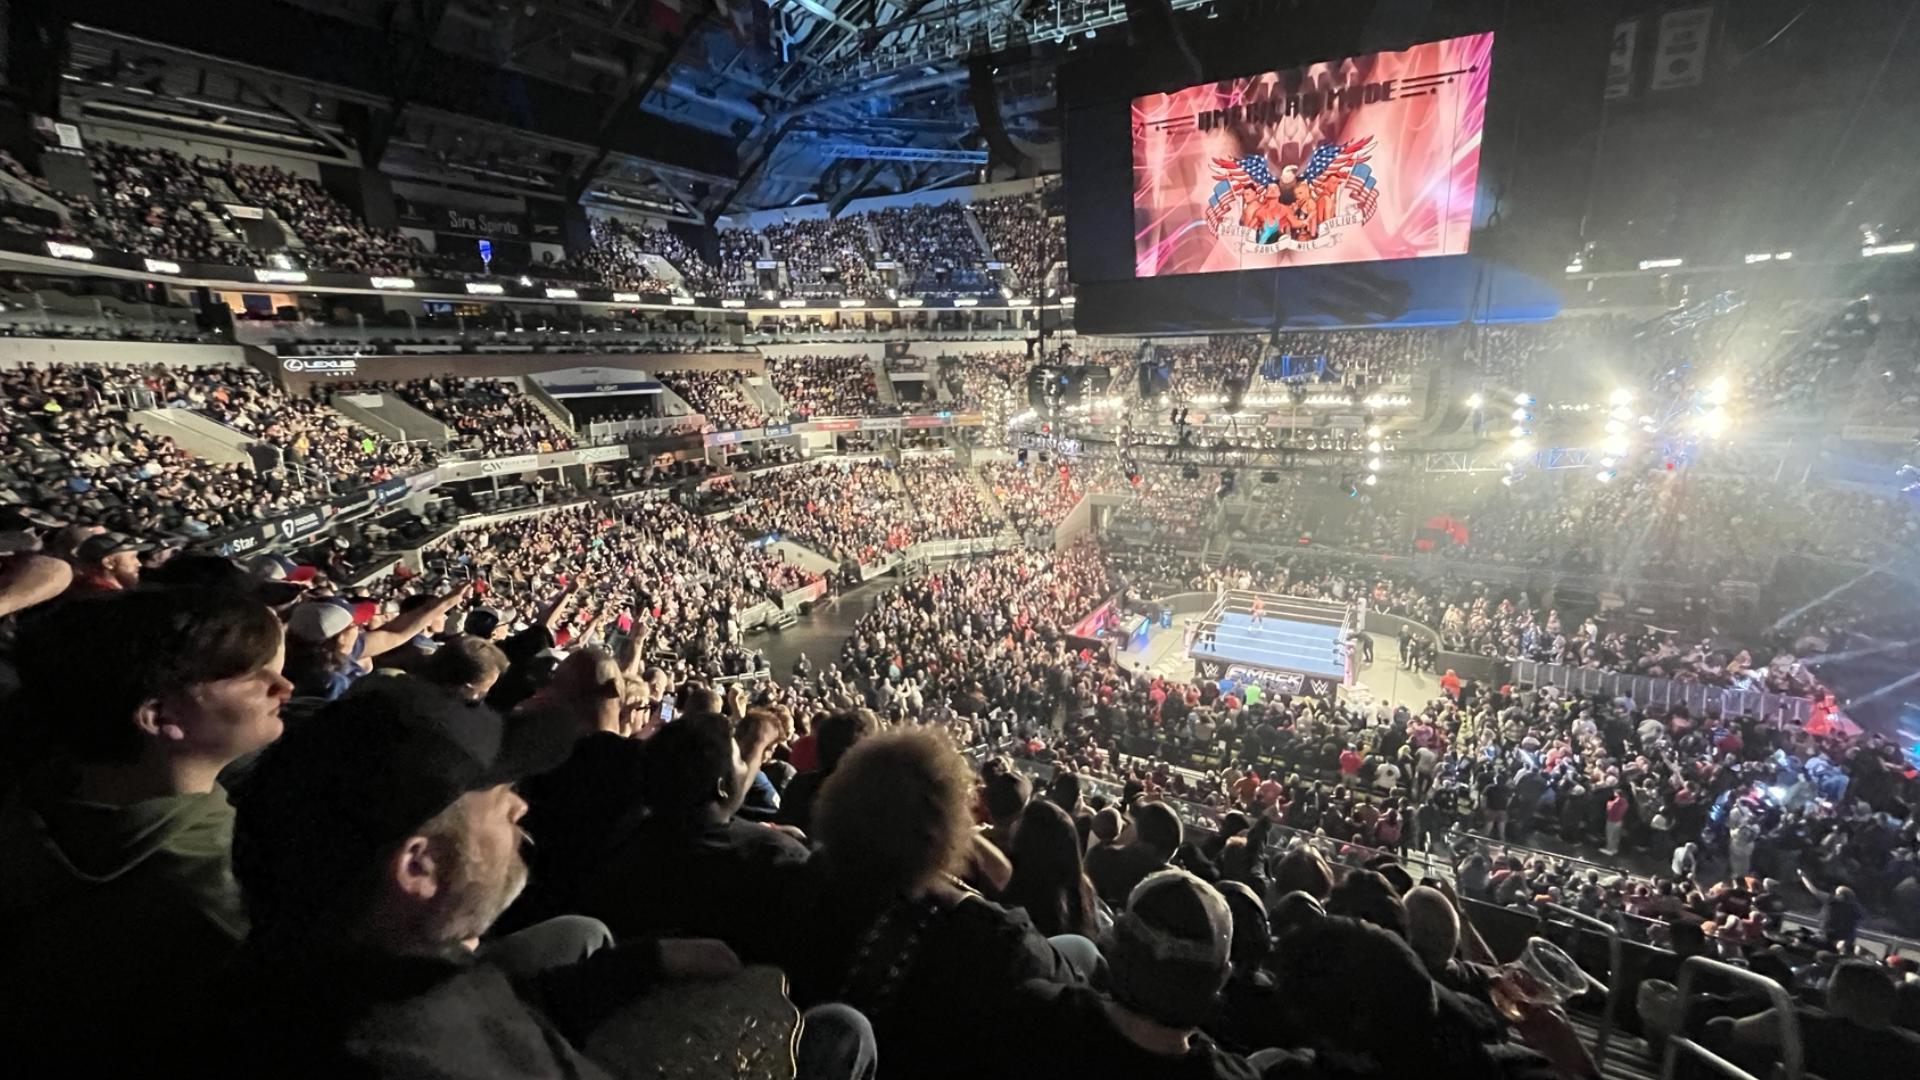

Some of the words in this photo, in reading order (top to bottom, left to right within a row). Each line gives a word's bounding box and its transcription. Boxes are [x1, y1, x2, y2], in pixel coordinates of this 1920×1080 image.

[448, 210, 476, 230] Sire
[1324, 215, 1358, 231] JULIUS
[1296, 242, 1317, 250] NILE
[303, 360, 357, 368] LEXUS
